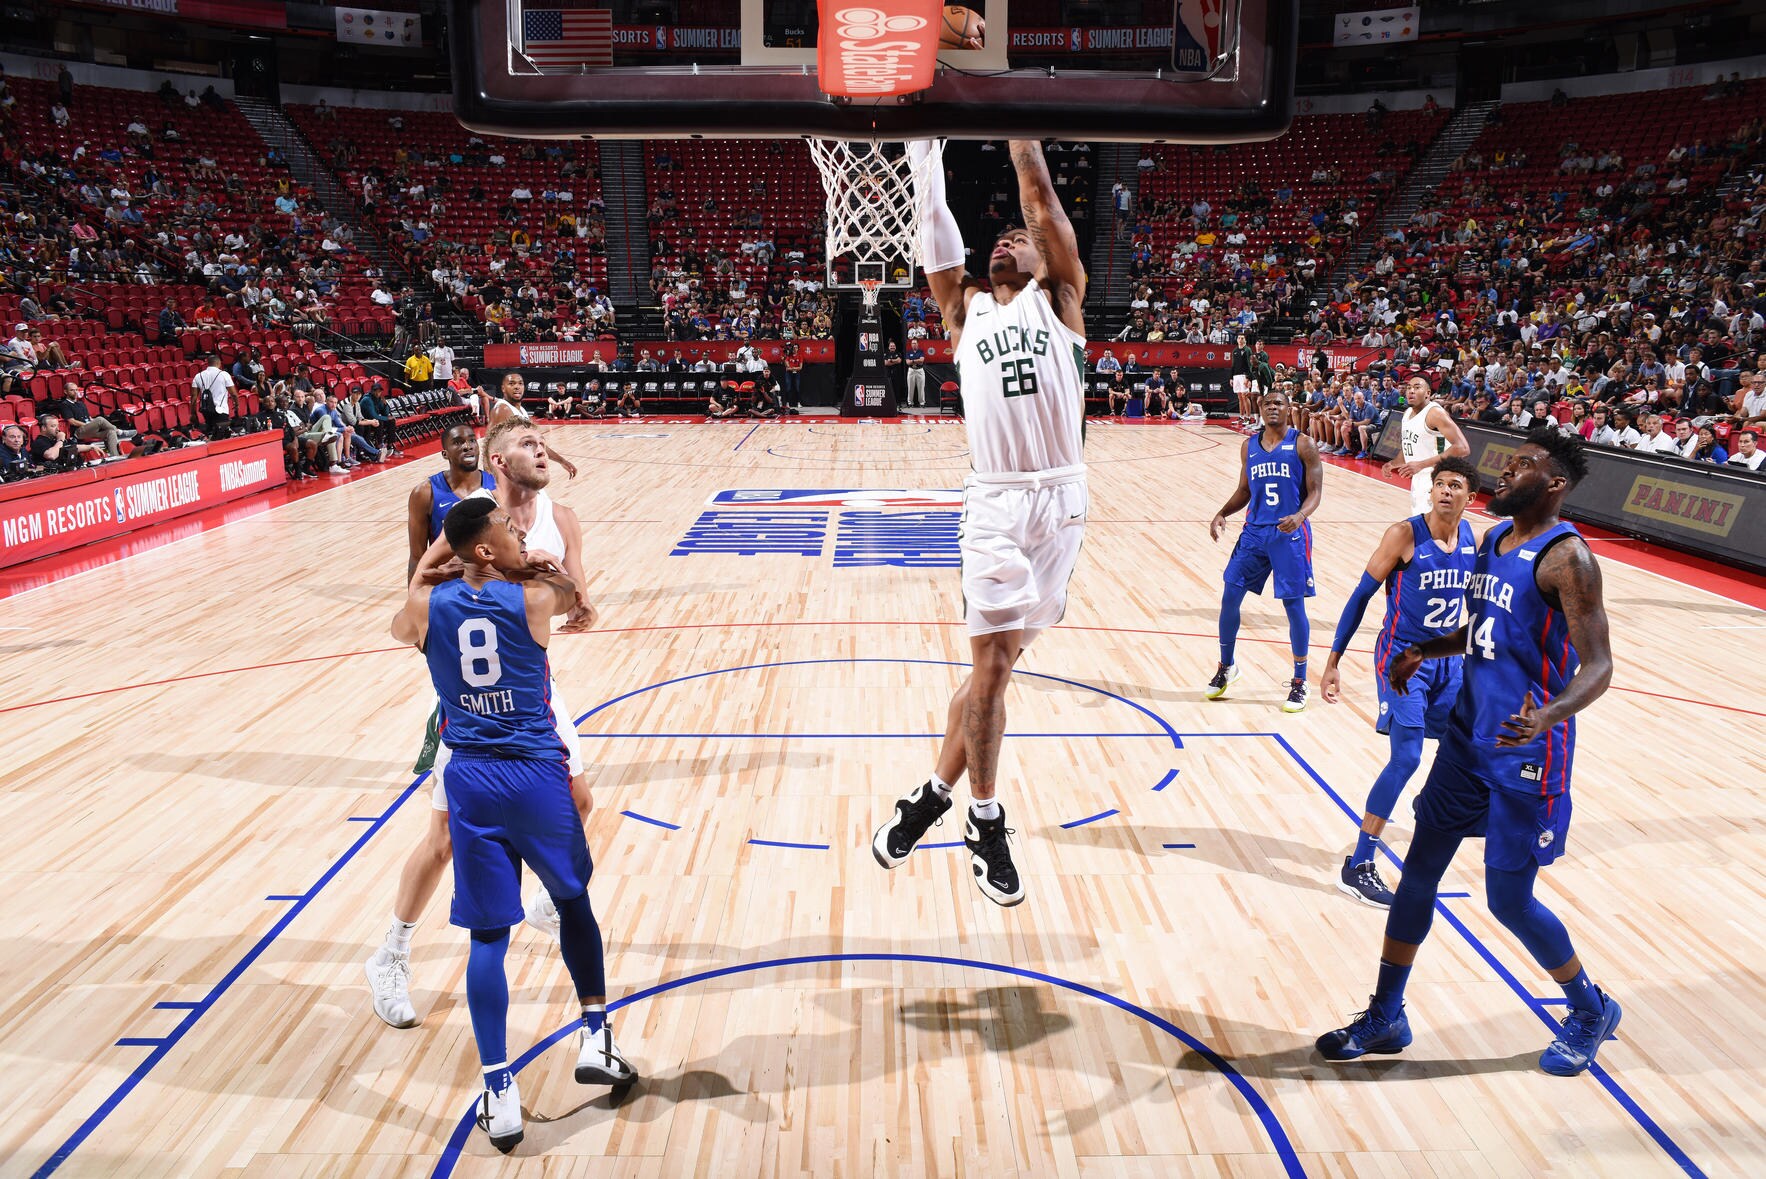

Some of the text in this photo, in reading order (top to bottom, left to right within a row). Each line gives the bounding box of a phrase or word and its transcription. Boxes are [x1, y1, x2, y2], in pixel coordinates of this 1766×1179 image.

[612, 28, 741, 48] SORTS SUMMER LEA
[784, 28, 805, 36] Bucks
[1013, 28, 1173, 48] RESORTS SUMMER LEAGUE
[1179, 49, 1201, 66] NBA
[529, 350, 584, 364] SUMMER LEAGUE
[976, 325, 1050, 364] BUCKS
[1001, 358, 1038, 398] 26
[1403, 430, 1419, 443] CKS
[219, 459, 268, 492] #NBASummer
[1250, 462, 1290, 480] PHILA
[1265, 483, 1279, 506] 5
[1631, 484, 1734, 527] PANINI
[3, 470, 201, 547] MGM RESORTS SUMMER LEAGUE
[1423, 598, 1460, 628] 22
[1466, 613, 1495, 660] 14
[457, 617, 502, 687] 8
[460, 689, 516, 715] SMITH
